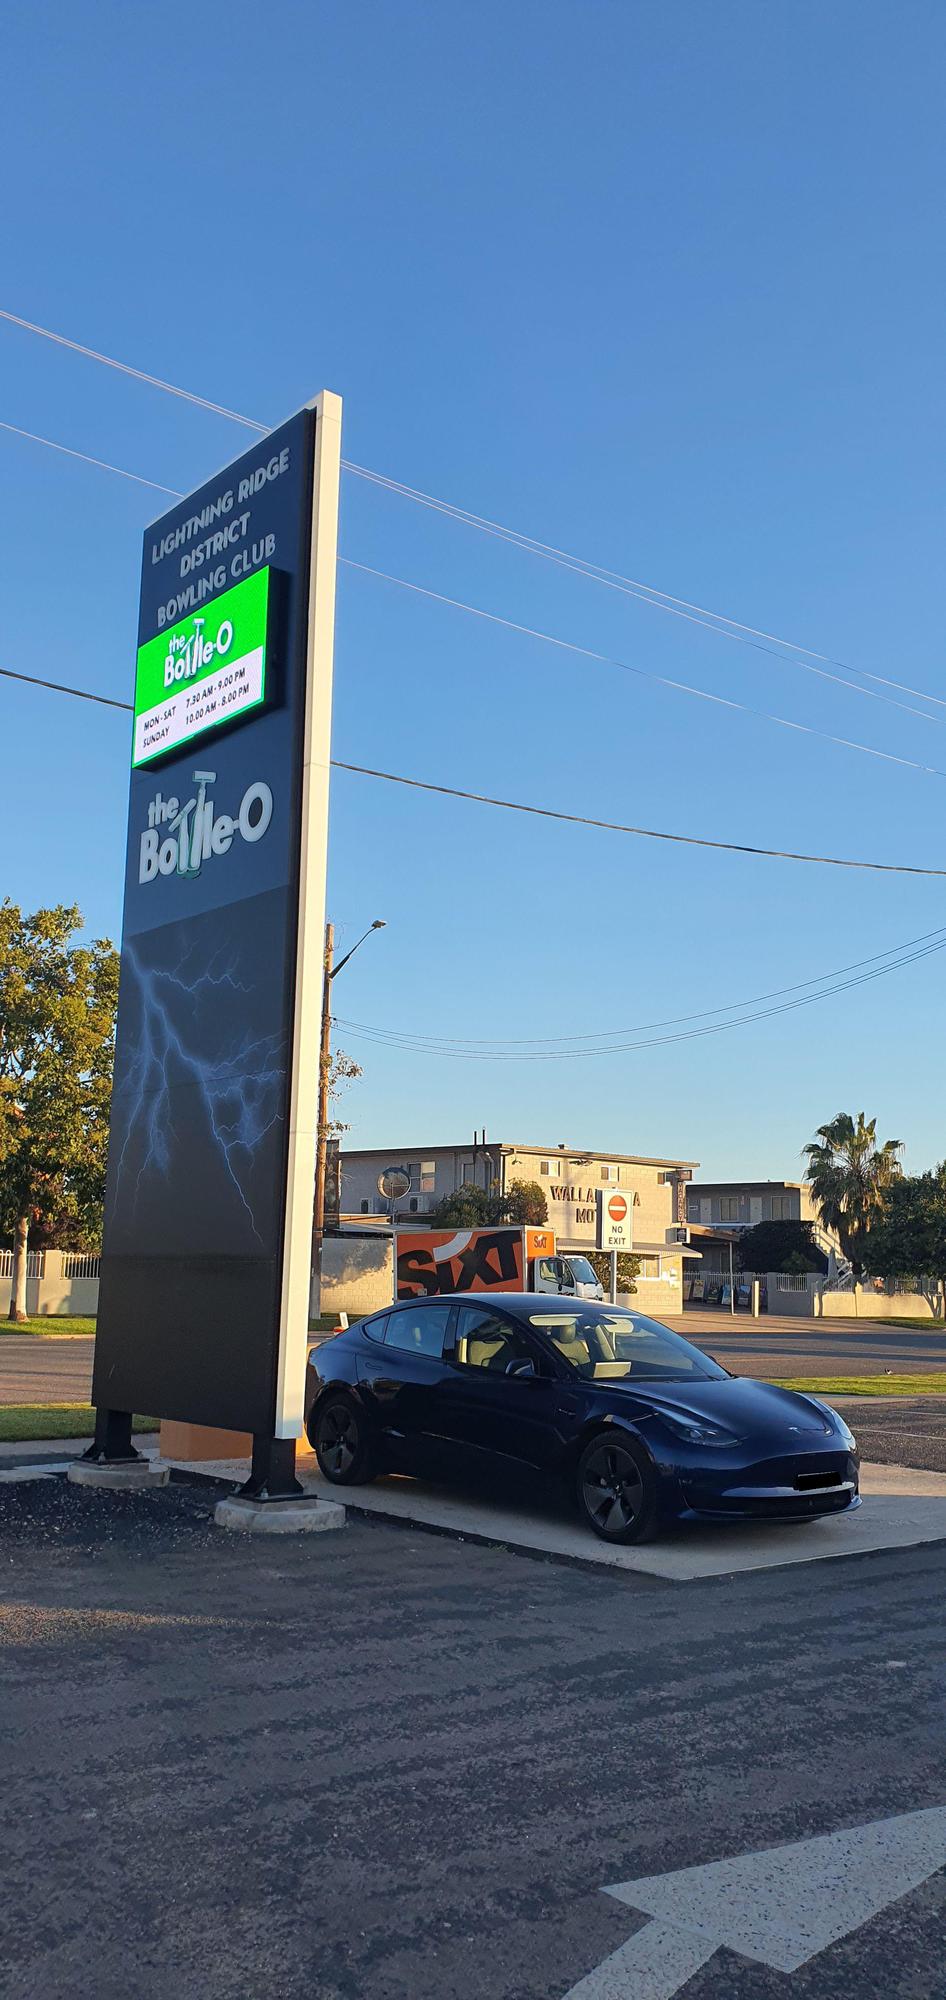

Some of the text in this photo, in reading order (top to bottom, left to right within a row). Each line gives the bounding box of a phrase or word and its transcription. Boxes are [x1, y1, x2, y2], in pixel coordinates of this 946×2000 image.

[152, 448, 290, 565] LIGHTNING RIDGE
[180, 511, 251, 578] DISTRICT
[157, 533, 276, 628] BOWLING CLUB
[169, 633, 186, 654] the
[186, 692, 201, 708] 7.30
[201, 685, 214, 700] AM
[217, 675, 233, 690] 9.00
[234, 667, 246, 682] PM
[186, 708, 204, 725] 10.00
[205, 701, 217, 715] AM
[221, 691, 237, 706] 8.00
[238, 683, 250, 697] PM
[143, 726, 170, 748] SUNDAY
[148, 792, 180, 827] the
[608, 1237, 626, 1245] EXIT
[611, 1226, 623, 1234] NO
